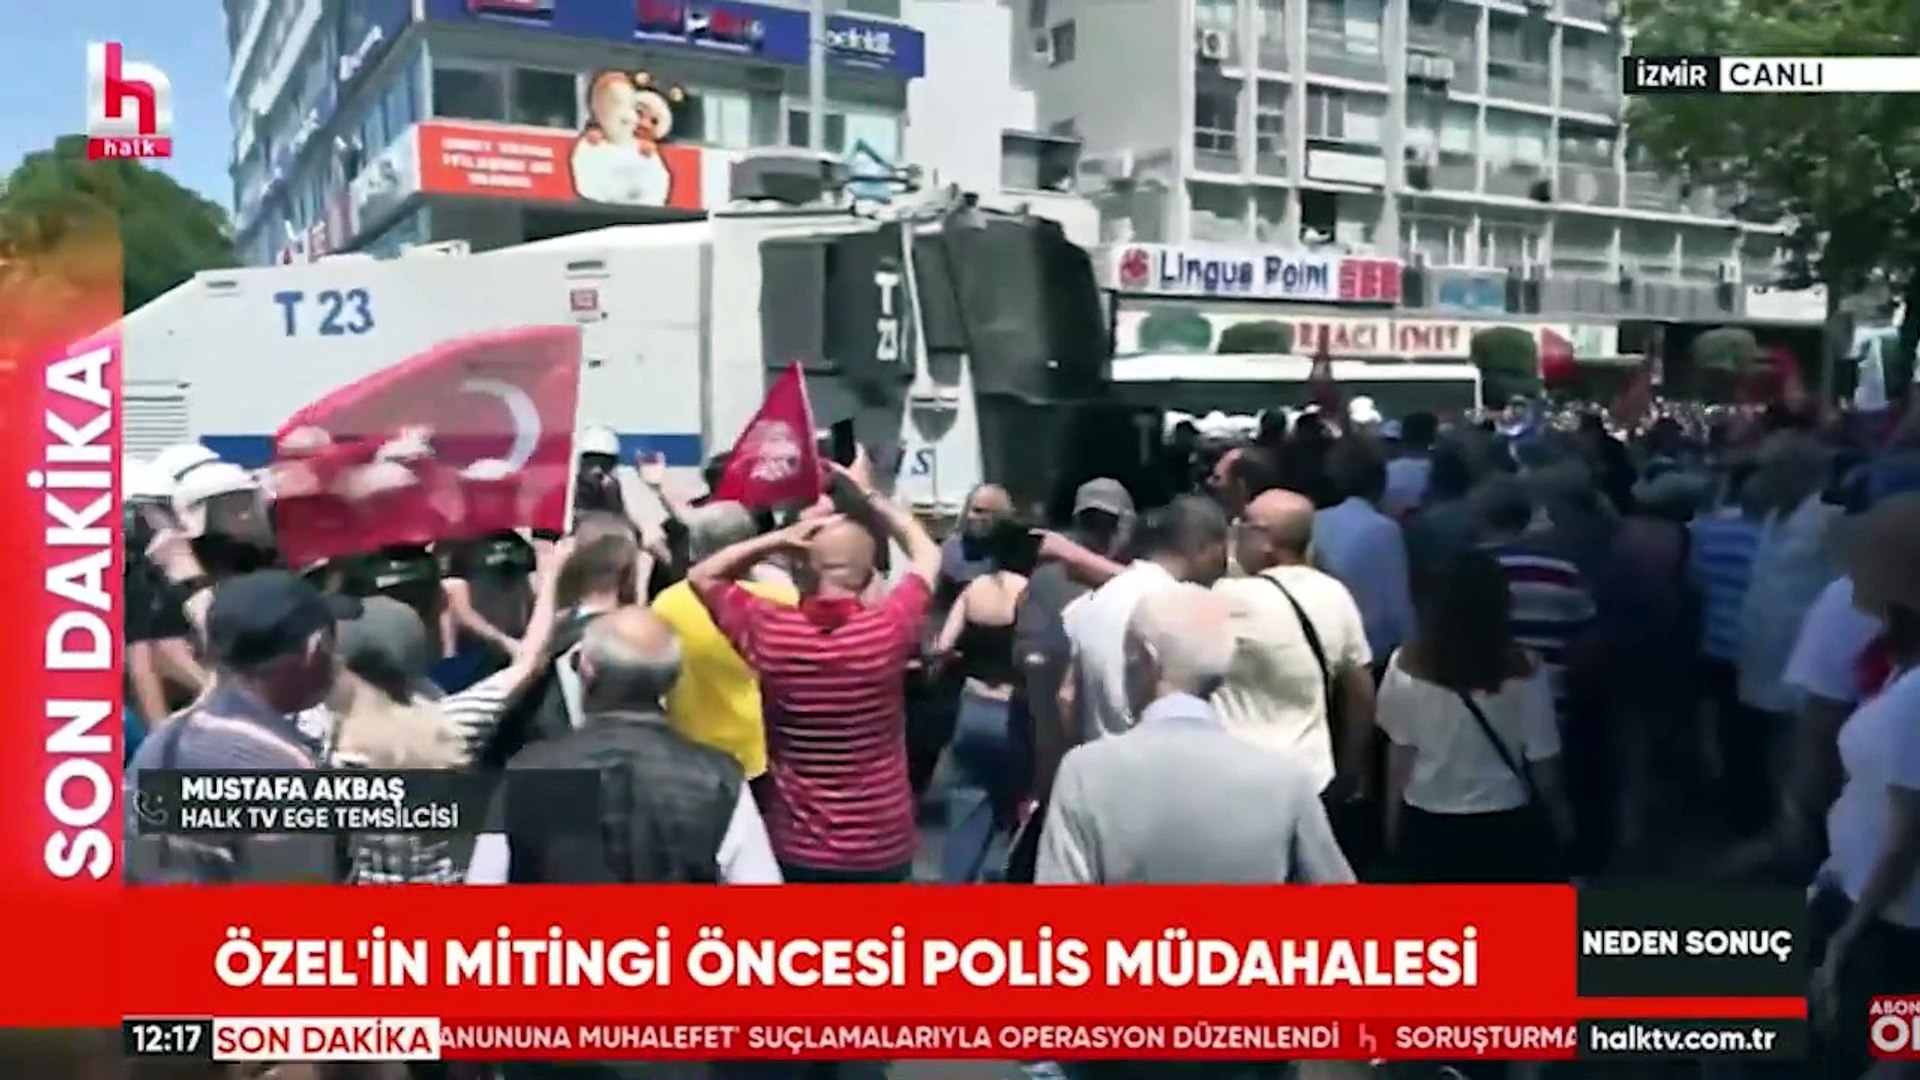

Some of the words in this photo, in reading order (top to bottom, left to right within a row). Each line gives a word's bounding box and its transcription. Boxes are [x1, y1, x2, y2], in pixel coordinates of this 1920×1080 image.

[274, 291, 304, 337] T
[317, 288, 375, 336] 23
[874, 271, 900, 315] T
